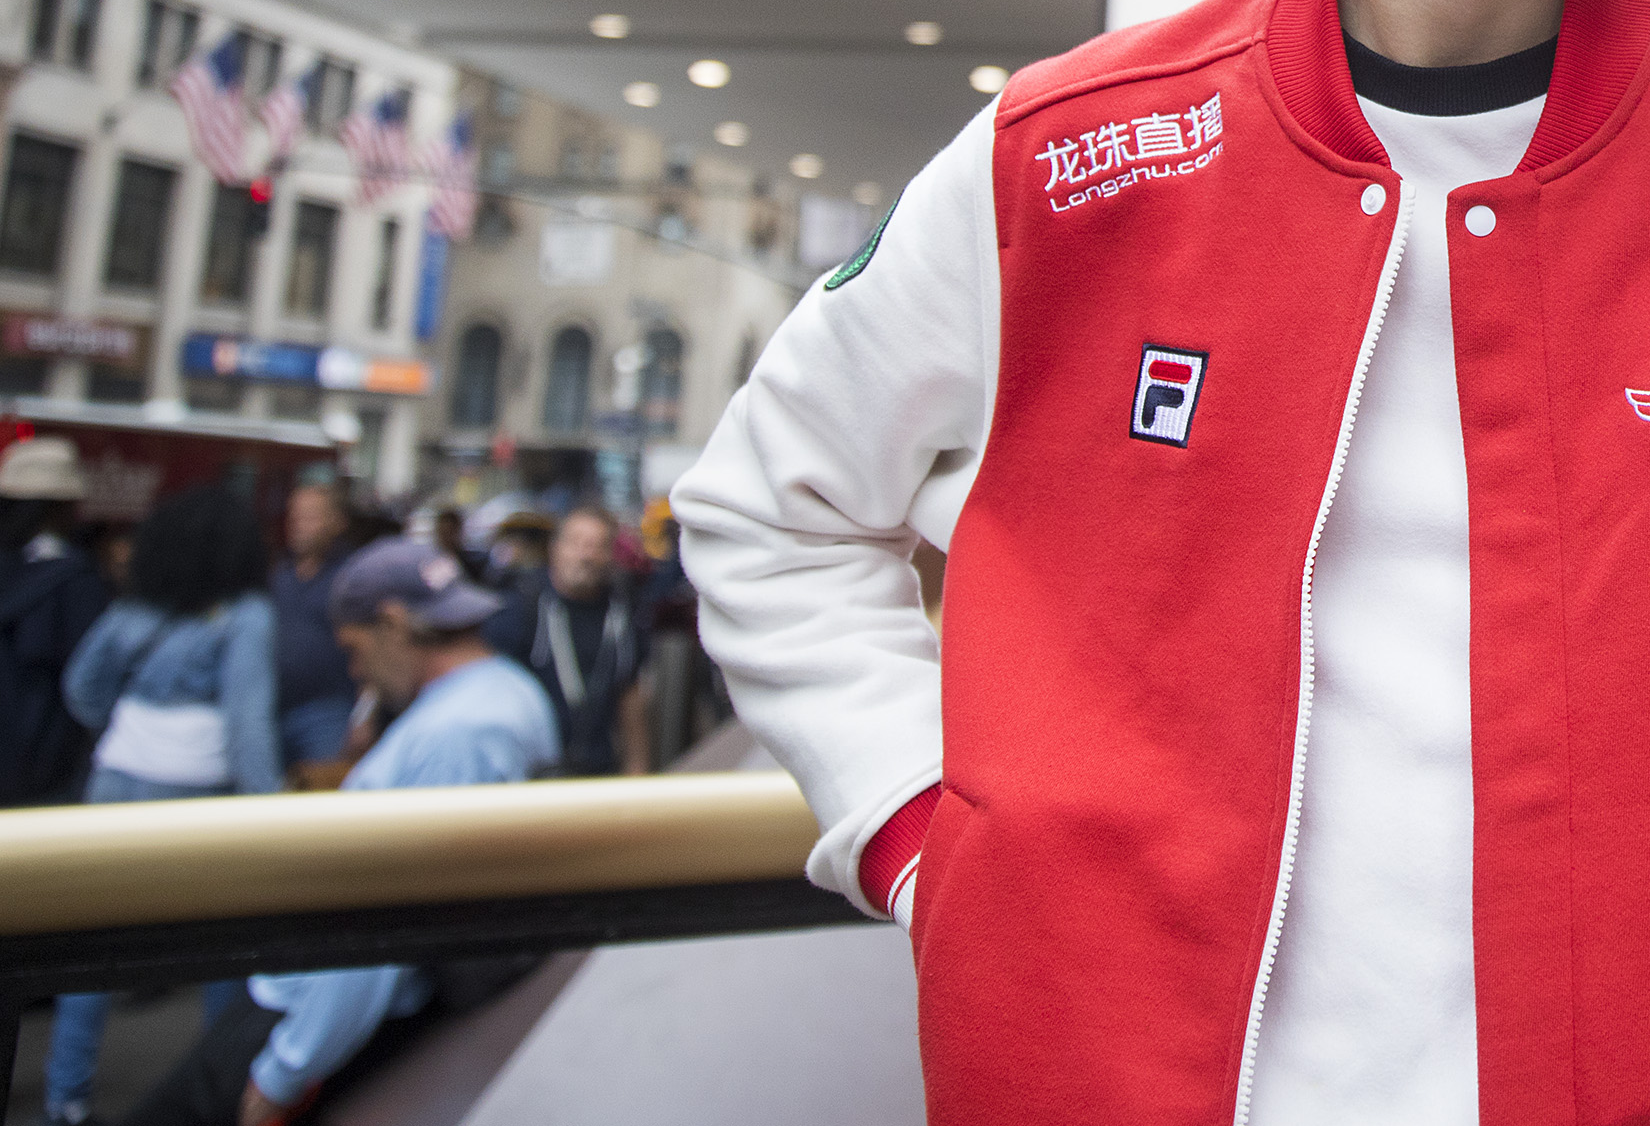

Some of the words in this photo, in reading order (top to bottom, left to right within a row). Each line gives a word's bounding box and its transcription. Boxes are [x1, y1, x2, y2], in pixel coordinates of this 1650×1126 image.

[1034, 91, 1223, 192] 龙珠直播
[1050, 141, 1223, 212] Longzhu.com
